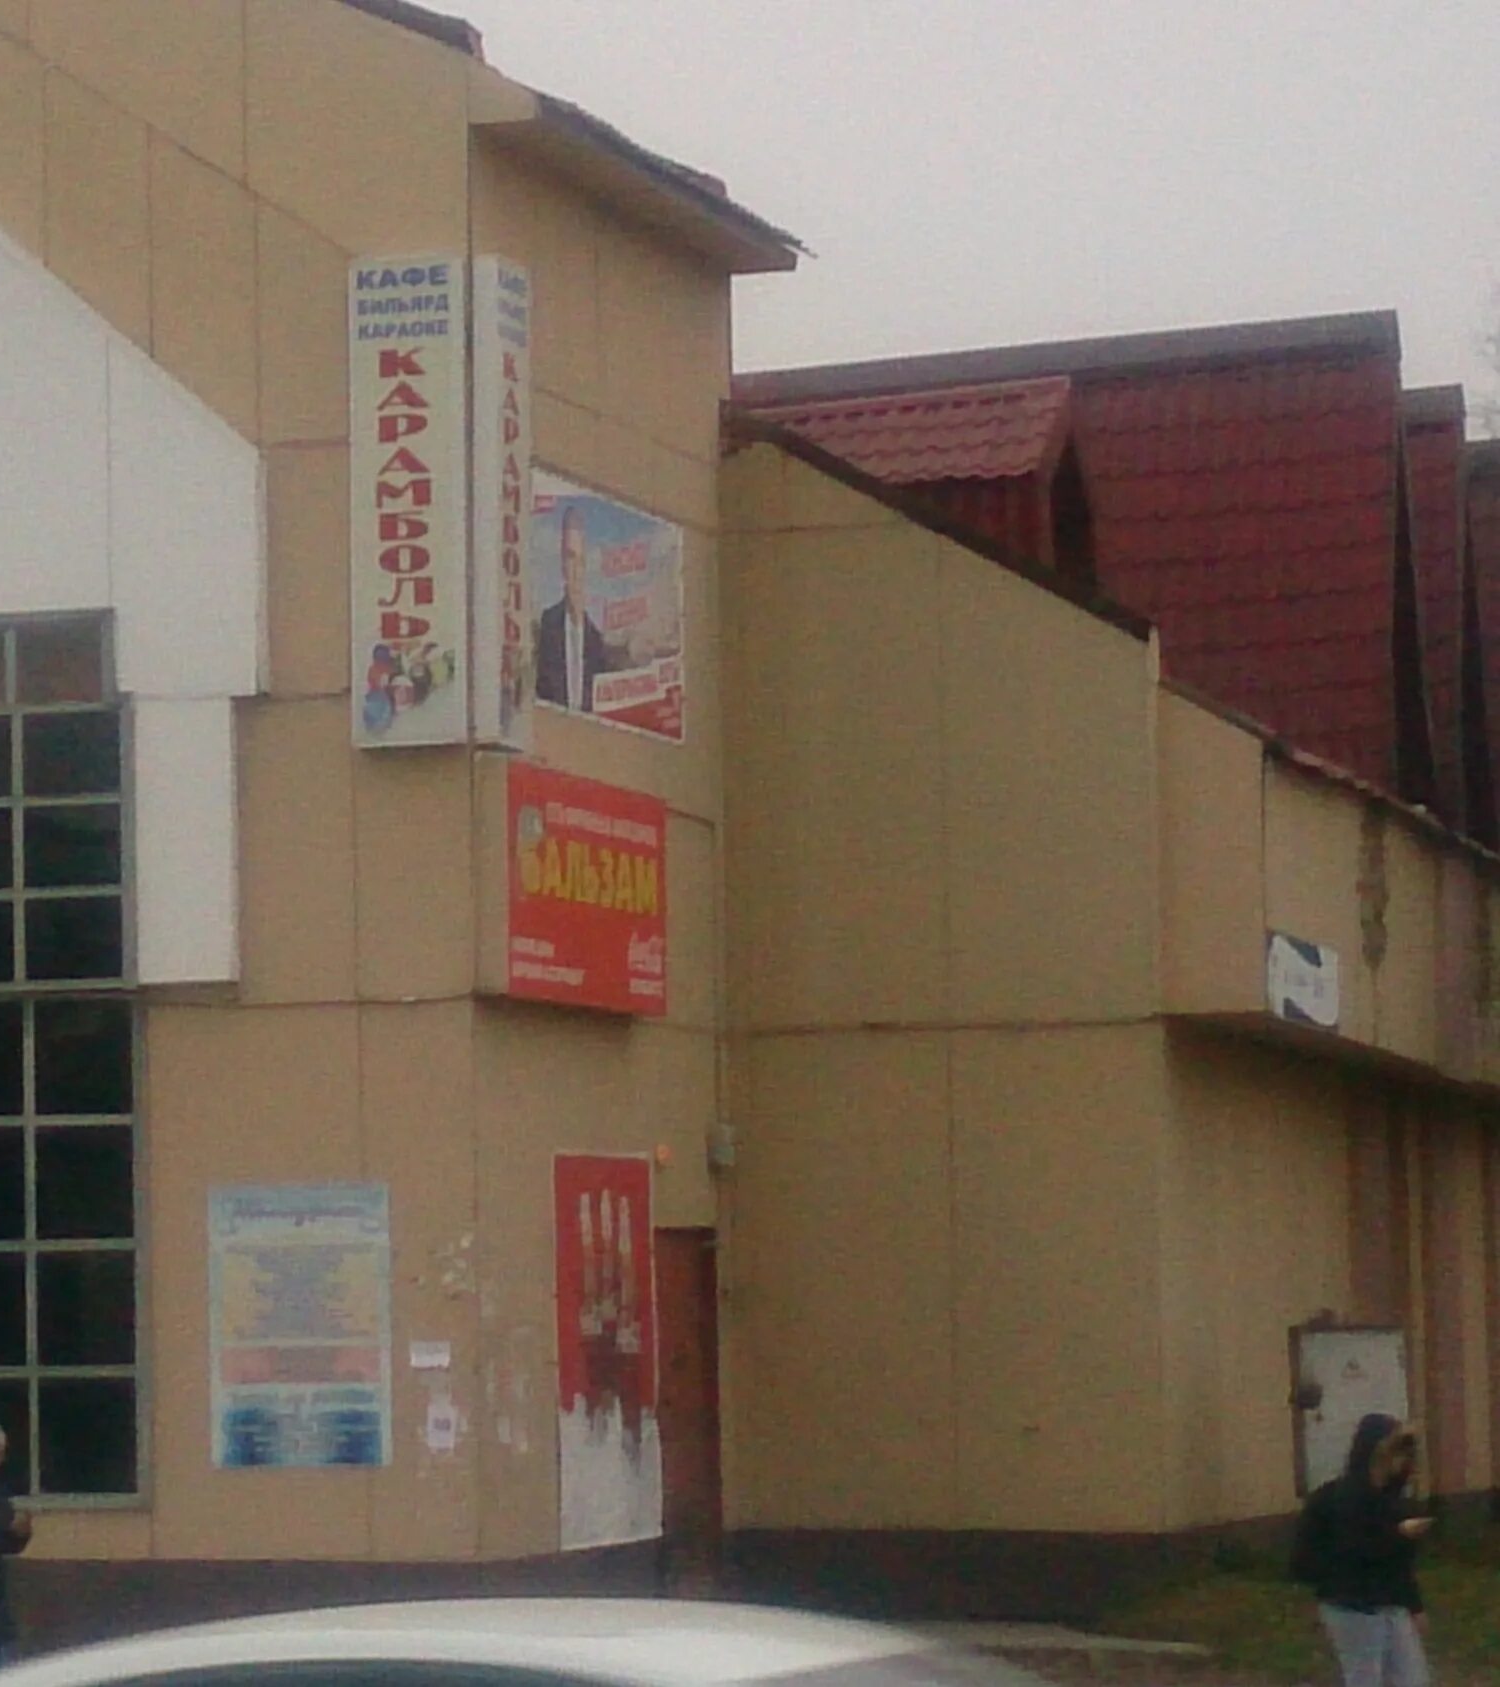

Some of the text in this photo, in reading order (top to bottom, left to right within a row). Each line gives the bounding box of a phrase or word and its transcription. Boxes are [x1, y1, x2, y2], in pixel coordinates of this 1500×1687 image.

[357, 264, 449, 290] КАФЕ
[357, 294, 449, 316] БИЛЬЯРД
[358, 319, 449, 339] КАРАОКЕ
[376, 346, 433, 640] КАРАМБОЛЬ
[503, 351, 521, 642] КАРАМБОЛЬ
[518, 836, 658, 917] БАЛЬЗАМ
